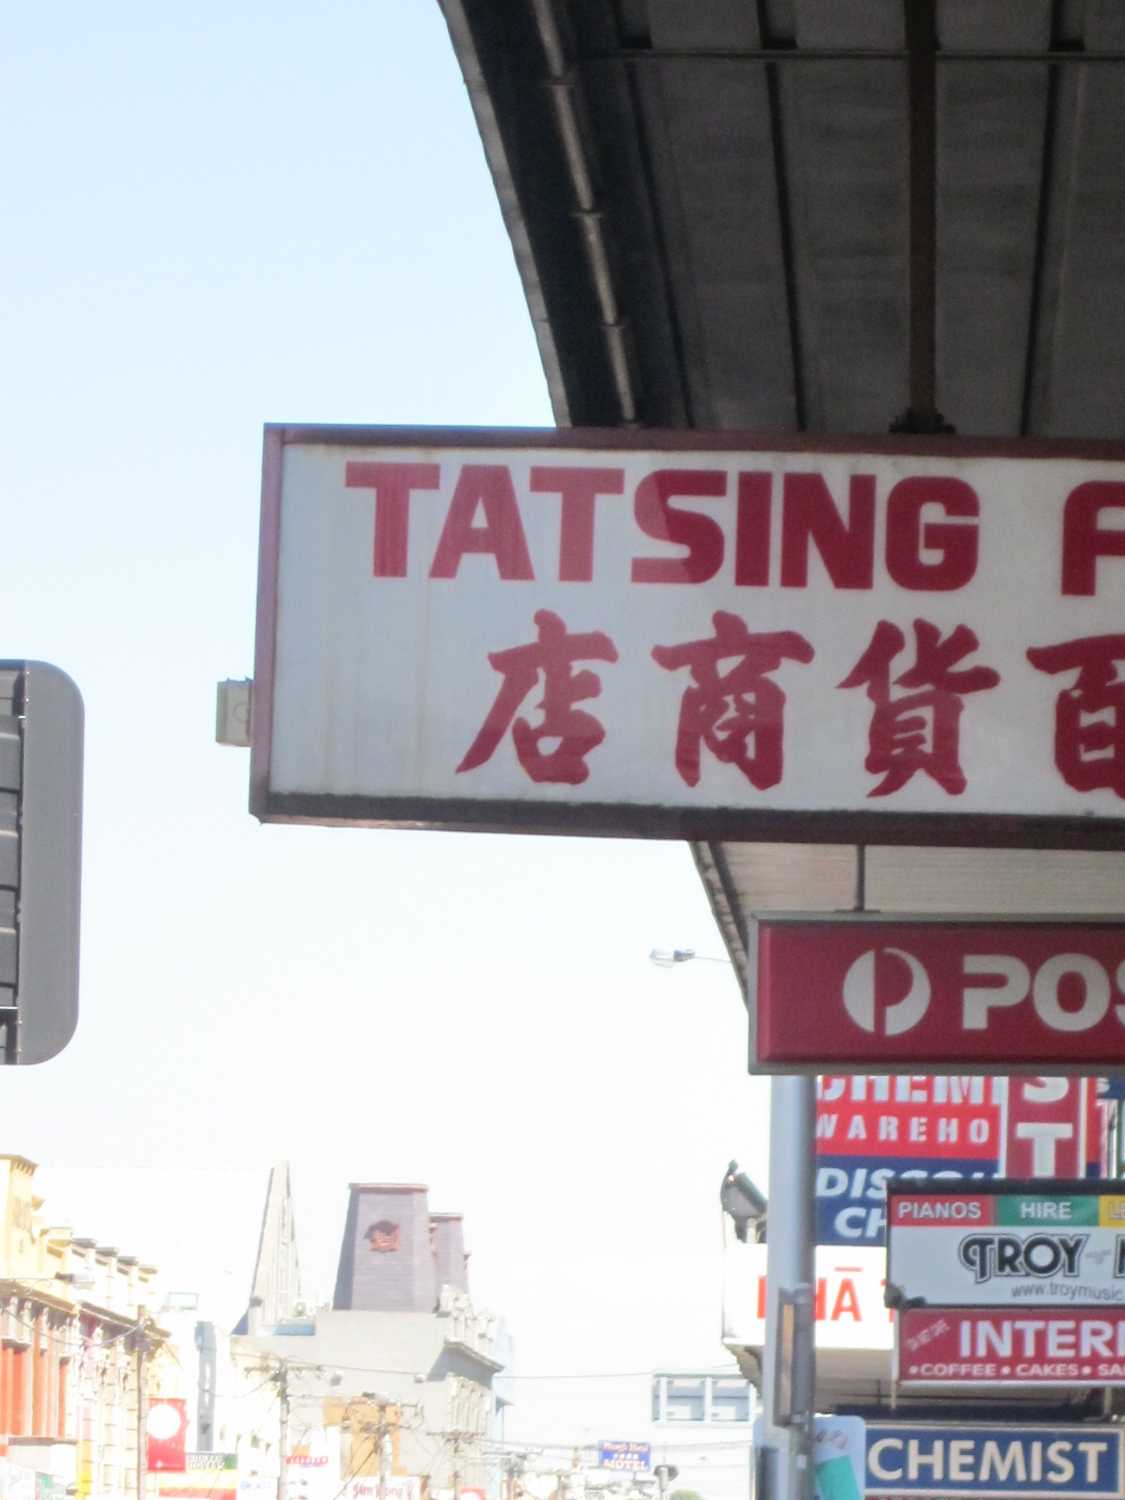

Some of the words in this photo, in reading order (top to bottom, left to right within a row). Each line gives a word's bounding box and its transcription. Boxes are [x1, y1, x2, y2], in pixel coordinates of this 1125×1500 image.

[345, 461, 980, 592] TATSING
[898, 1201, 982, 1219] PIANOS
[1020, 1201, 1072, 1219] HIRE
[959, 1232, 1090, 1284] TROY
[920, 1363, 996, 1378] COFFEE
[1016, 1363, 1079, 1378] CAKES
[867, 1438, 1108, 1484] CHEMIST
